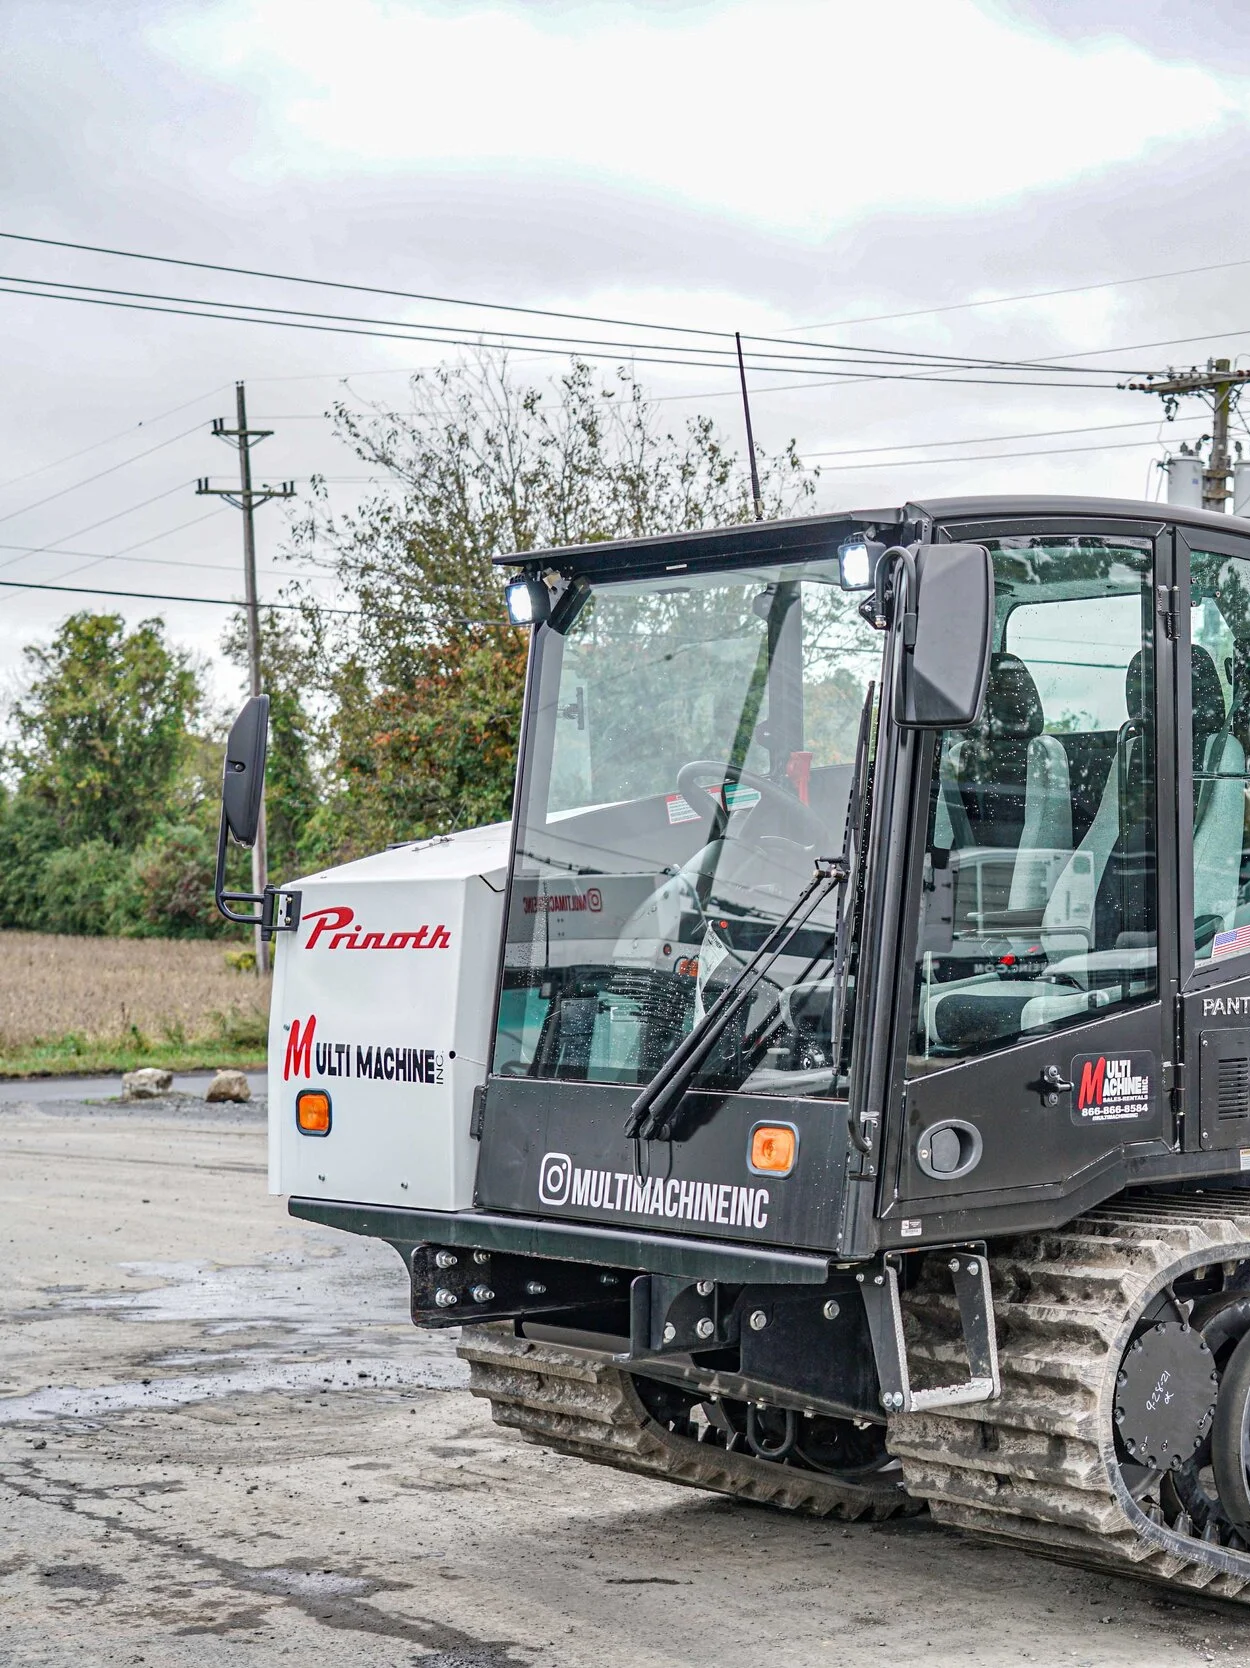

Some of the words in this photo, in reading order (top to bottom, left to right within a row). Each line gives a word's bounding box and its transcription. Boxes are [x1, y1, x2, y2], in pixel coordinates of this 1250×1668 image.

[302, 906, 452, 950] Prinoth
[284, 1014, 351, 1081] MULTI
[356, 1045, 435, 1084] MACHINE
[1081, 1103, 1149, 1117] 866-866-8584
[571, 1168, 769, 1229] MULTIMACHINEINC
